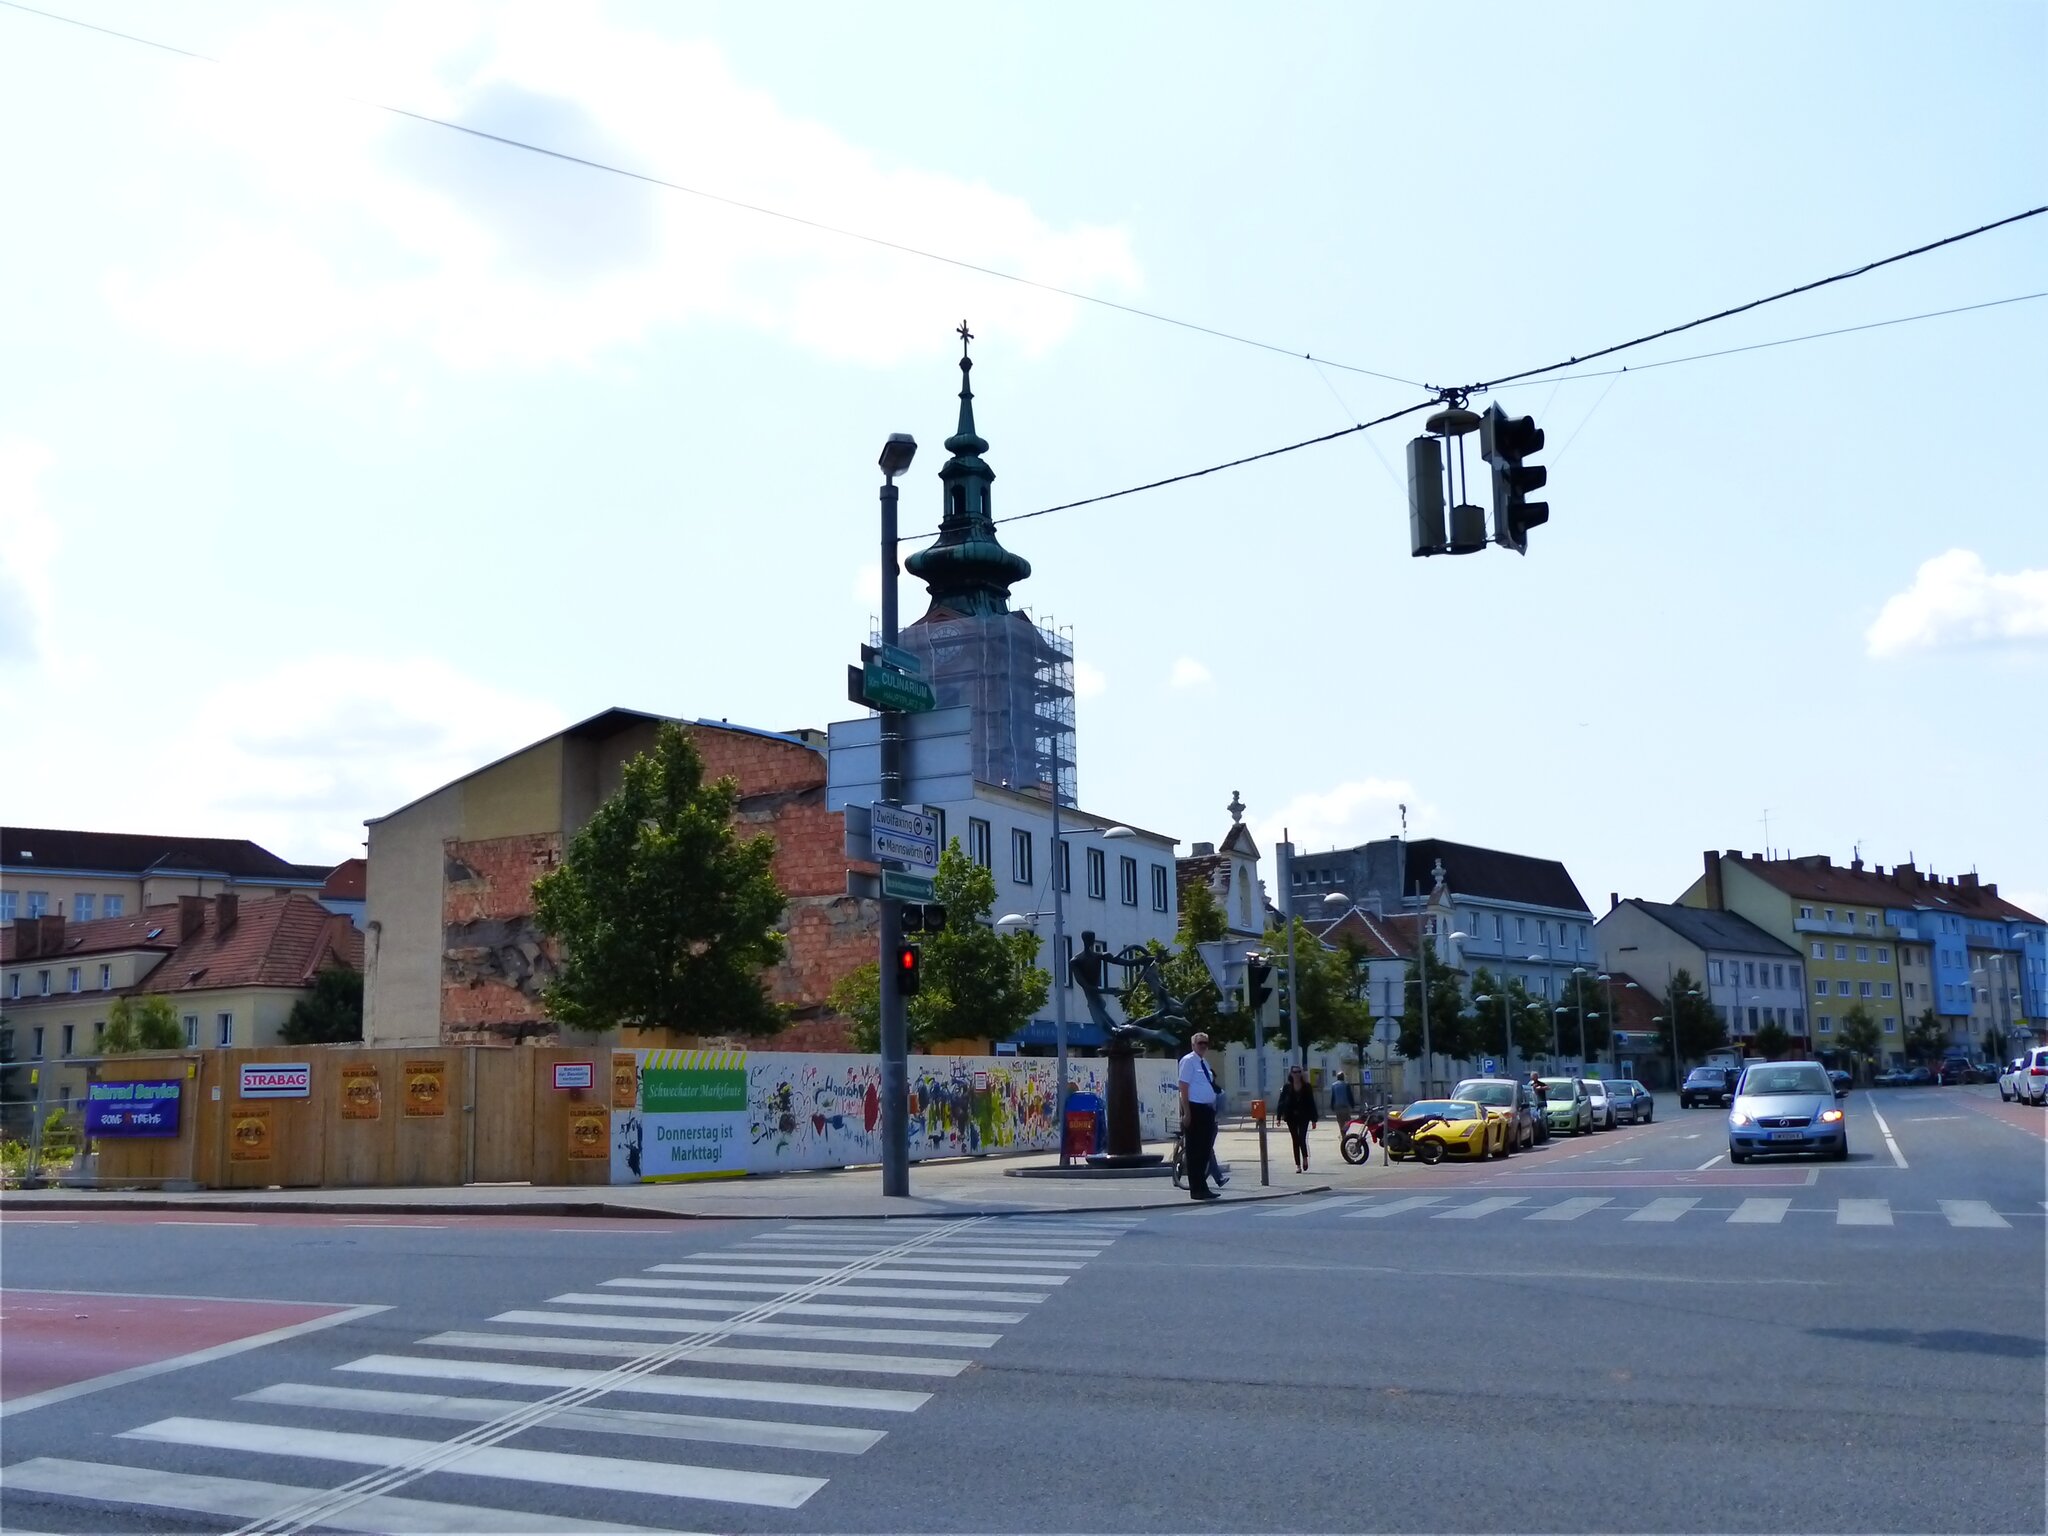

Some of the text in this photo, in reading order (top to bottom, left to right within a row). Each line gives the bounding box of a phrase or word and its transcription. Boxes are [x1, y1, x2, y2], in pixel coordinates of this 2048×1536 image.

[881, 672, 928, 698] CULINARIUM
[876, 810, 913, 832] Zwölfaxing
[886, 839, 923, 859] Mannswörth
[244, 1074, 307, 1086] STRABAG
[135, 1083, 180, 1099] Service
[648, 1082, 699, 1098] Schwechater
[657, 1123, 733, 1142] Donnerstag ist
[671, 1144, 723, 1163] Markttag!
